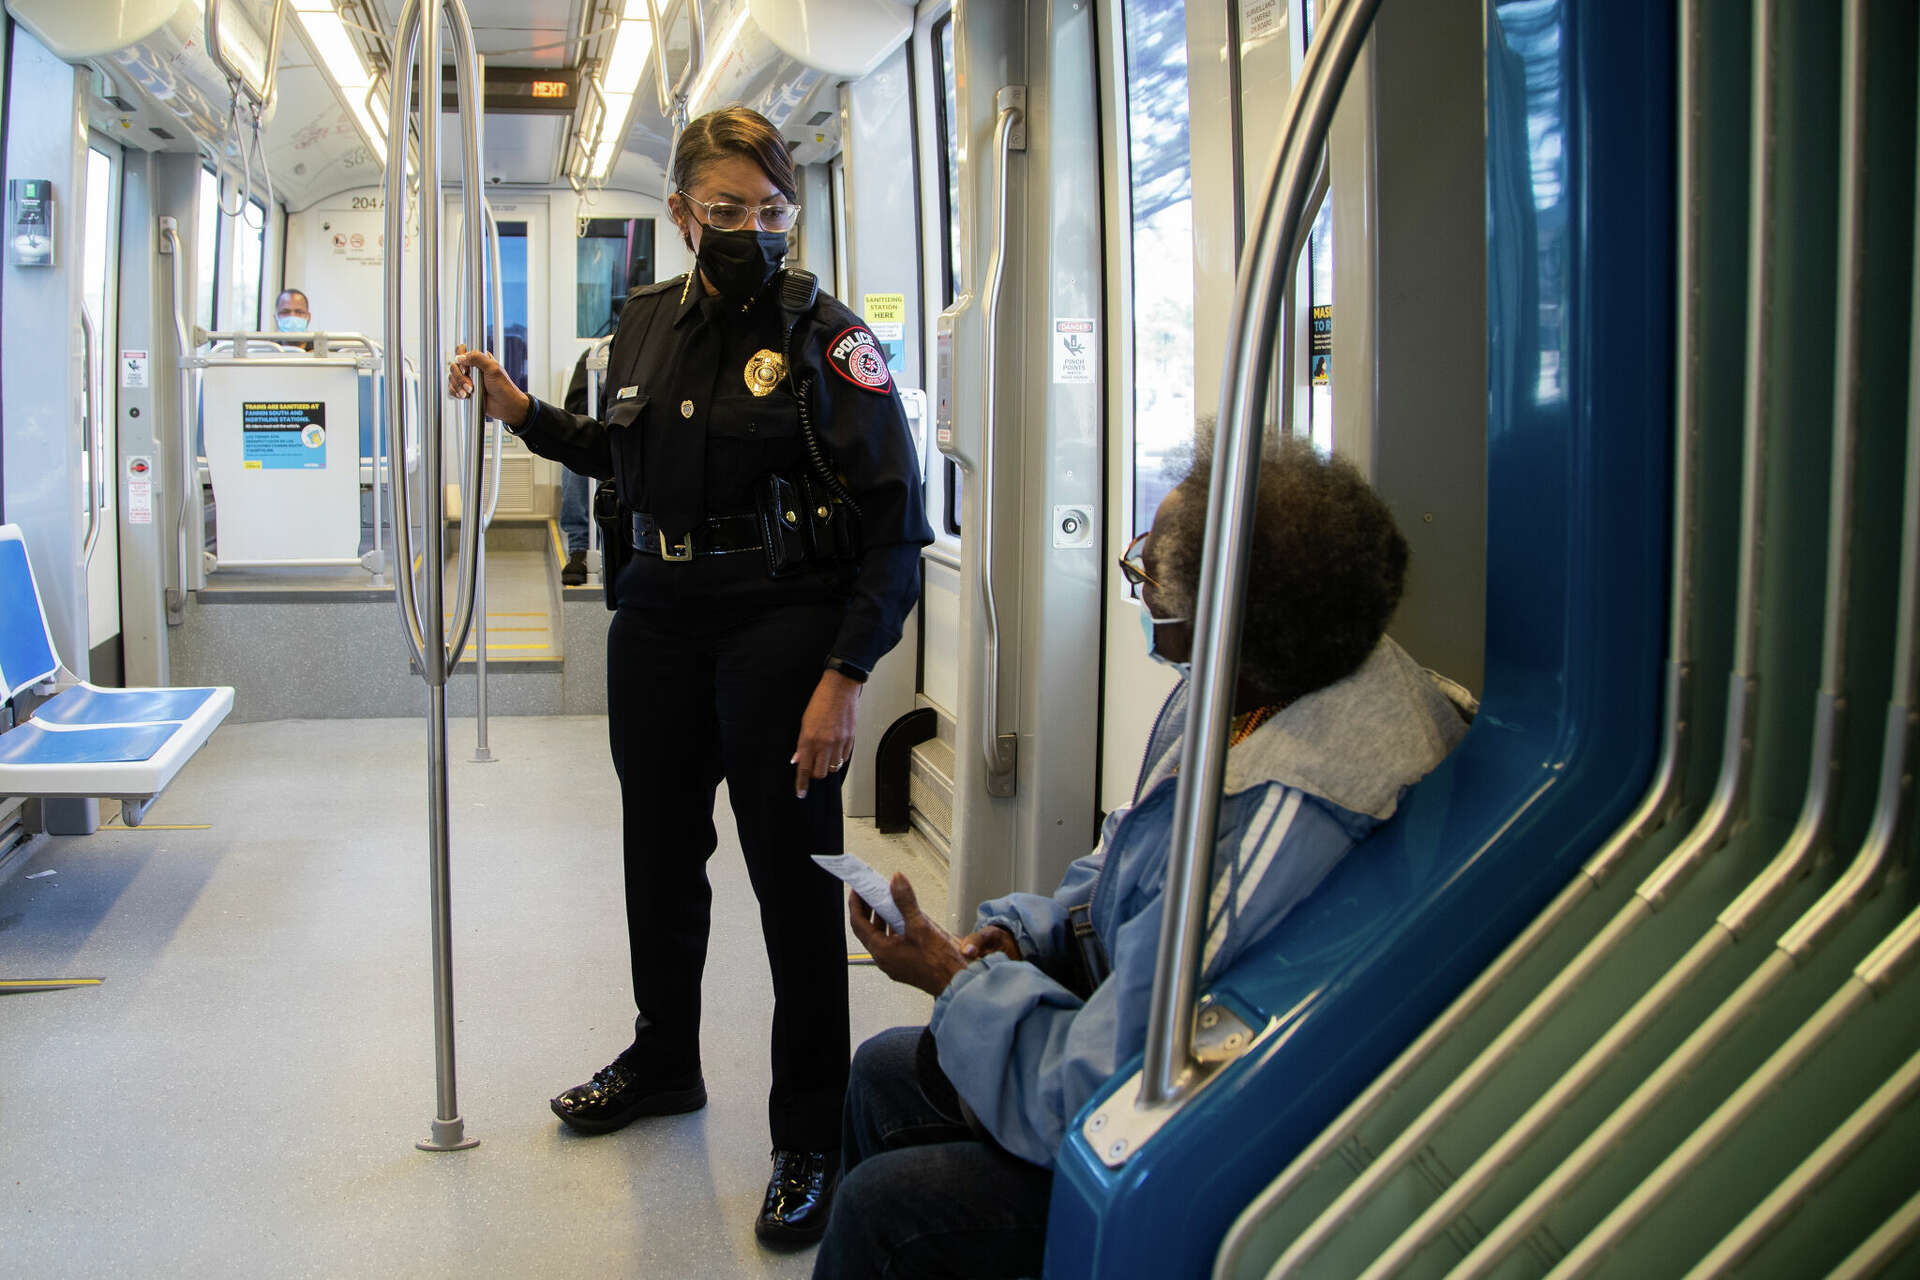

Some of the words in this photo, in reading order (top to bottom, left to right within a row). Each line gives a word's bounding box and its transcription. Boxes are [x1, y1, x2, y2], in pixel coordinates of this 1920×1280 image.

[532, 81, 568, 98] NEXT
[352, 196, 377, 209] 204
[1060, 322, 1090, 332] DANGER
[833, 331, 875, 360] POLICE
